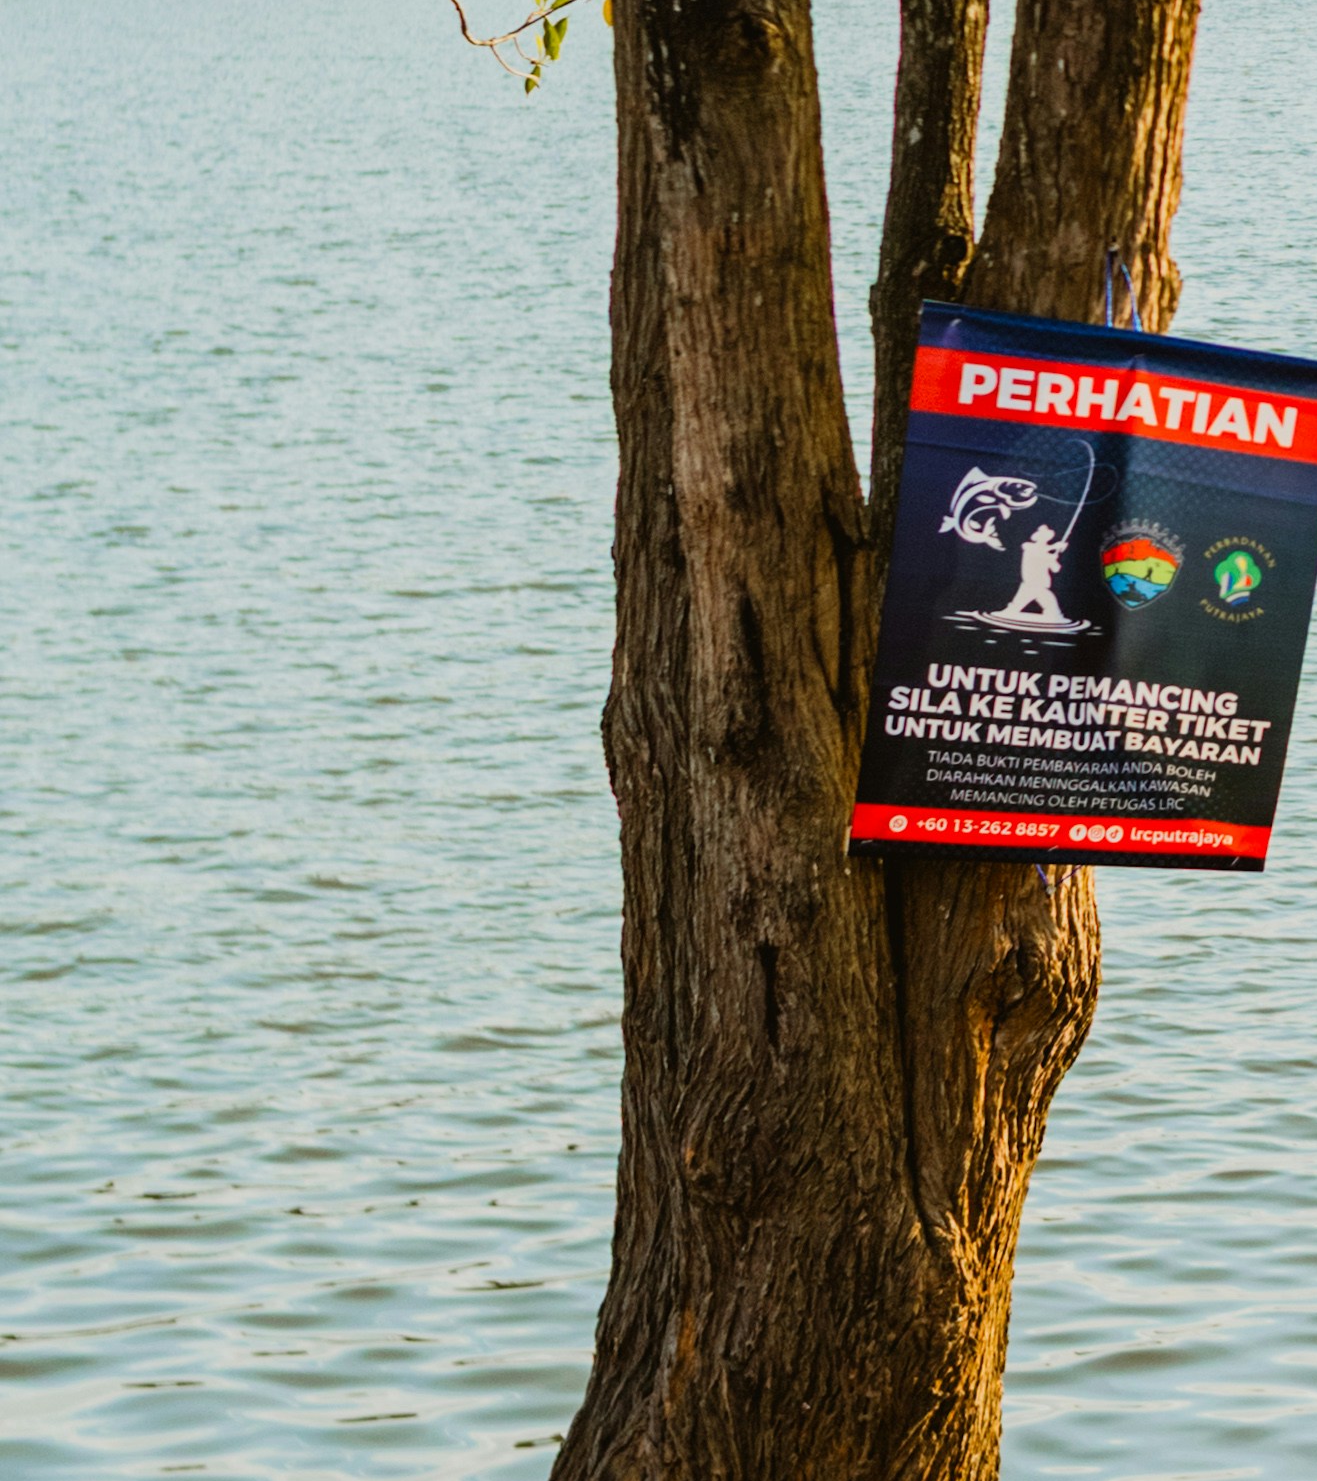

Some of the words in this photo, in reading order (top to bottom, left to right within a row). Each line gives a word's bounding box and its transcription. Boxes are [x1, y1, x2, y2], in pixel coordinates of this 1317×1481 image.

[958, 363, 1298, 448] PERHATIAN
[1199, 598, 1265, 624] PUTRAJAYA
[928, 663, 1043, 696] UNTUK
[1048, 674, 1239, 716] PEMANCING
[888, 686, 962, 715] SILA
[969, 693, 1016, 719] KE
[1020, 698, 1170, 732] KAUNTER
[1176, 713, 1271, 743] TIKET
[884, 715, 983, 743] UNTUK
[986, 724, 1122, 752] MEMBUAT
[1124, 732, 1261, 766] BAYARAN
[927, 750, 974, 766] TIADA
[976, 754, 1020, 769] BUKTI
[1022, 758, 1119, 775] PEMBAYARAN
[1121, 761, 1163, 775] ANDA
[1166, 764, 1216, 782] BOLEH
[926, 769, 1017, 787] DIARAHKAN
[1018, 777, 1137, 793] MENINGGALKAN
[1139, 780, 1212, 798] KAWASAN
[950, 789, 1045, 806] MEMANCING
[1047, 795, 1088, 808] OLEH
[1090, 797, 1156, 811] PETUGAS
[1159, 797, 1186, 811] LRC
[916, 817, 948, 832] +60
[953, 818, 1013, 835] 13-262
[1015, 822, 1061, 838] 8857
[1130, 827, 1234, 848] lrcputrajaya
